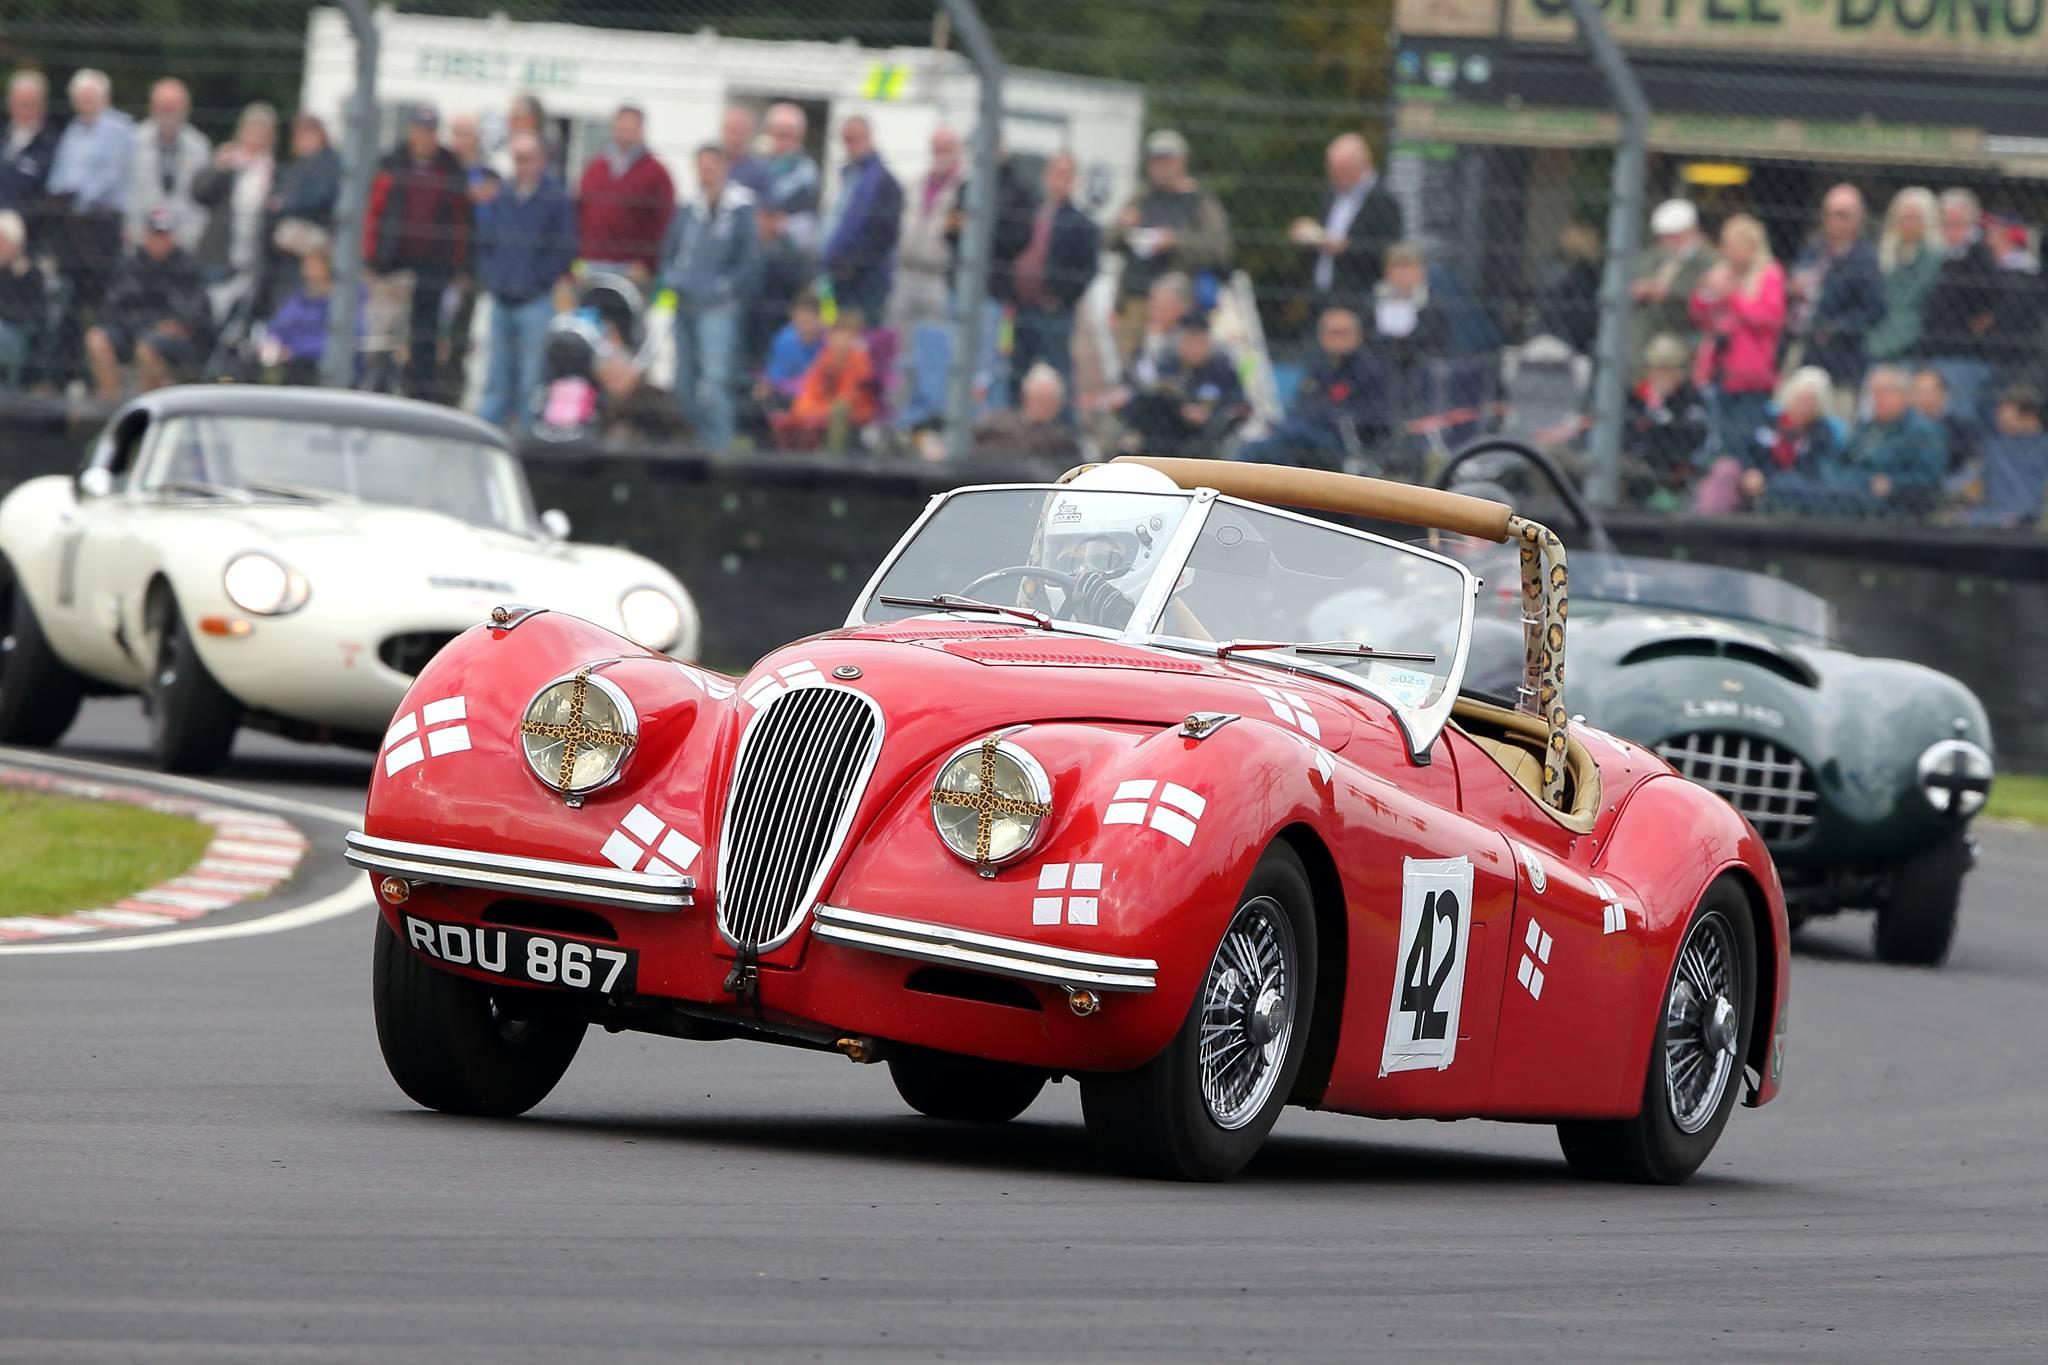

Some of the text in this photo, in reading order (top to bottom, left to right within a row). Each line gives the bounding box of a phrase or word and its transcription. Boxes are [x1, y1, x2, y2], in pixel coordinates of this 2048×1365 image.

[406, 915, 628, 994] RDU 867
[1400, 889, 1460, 1041] 42
